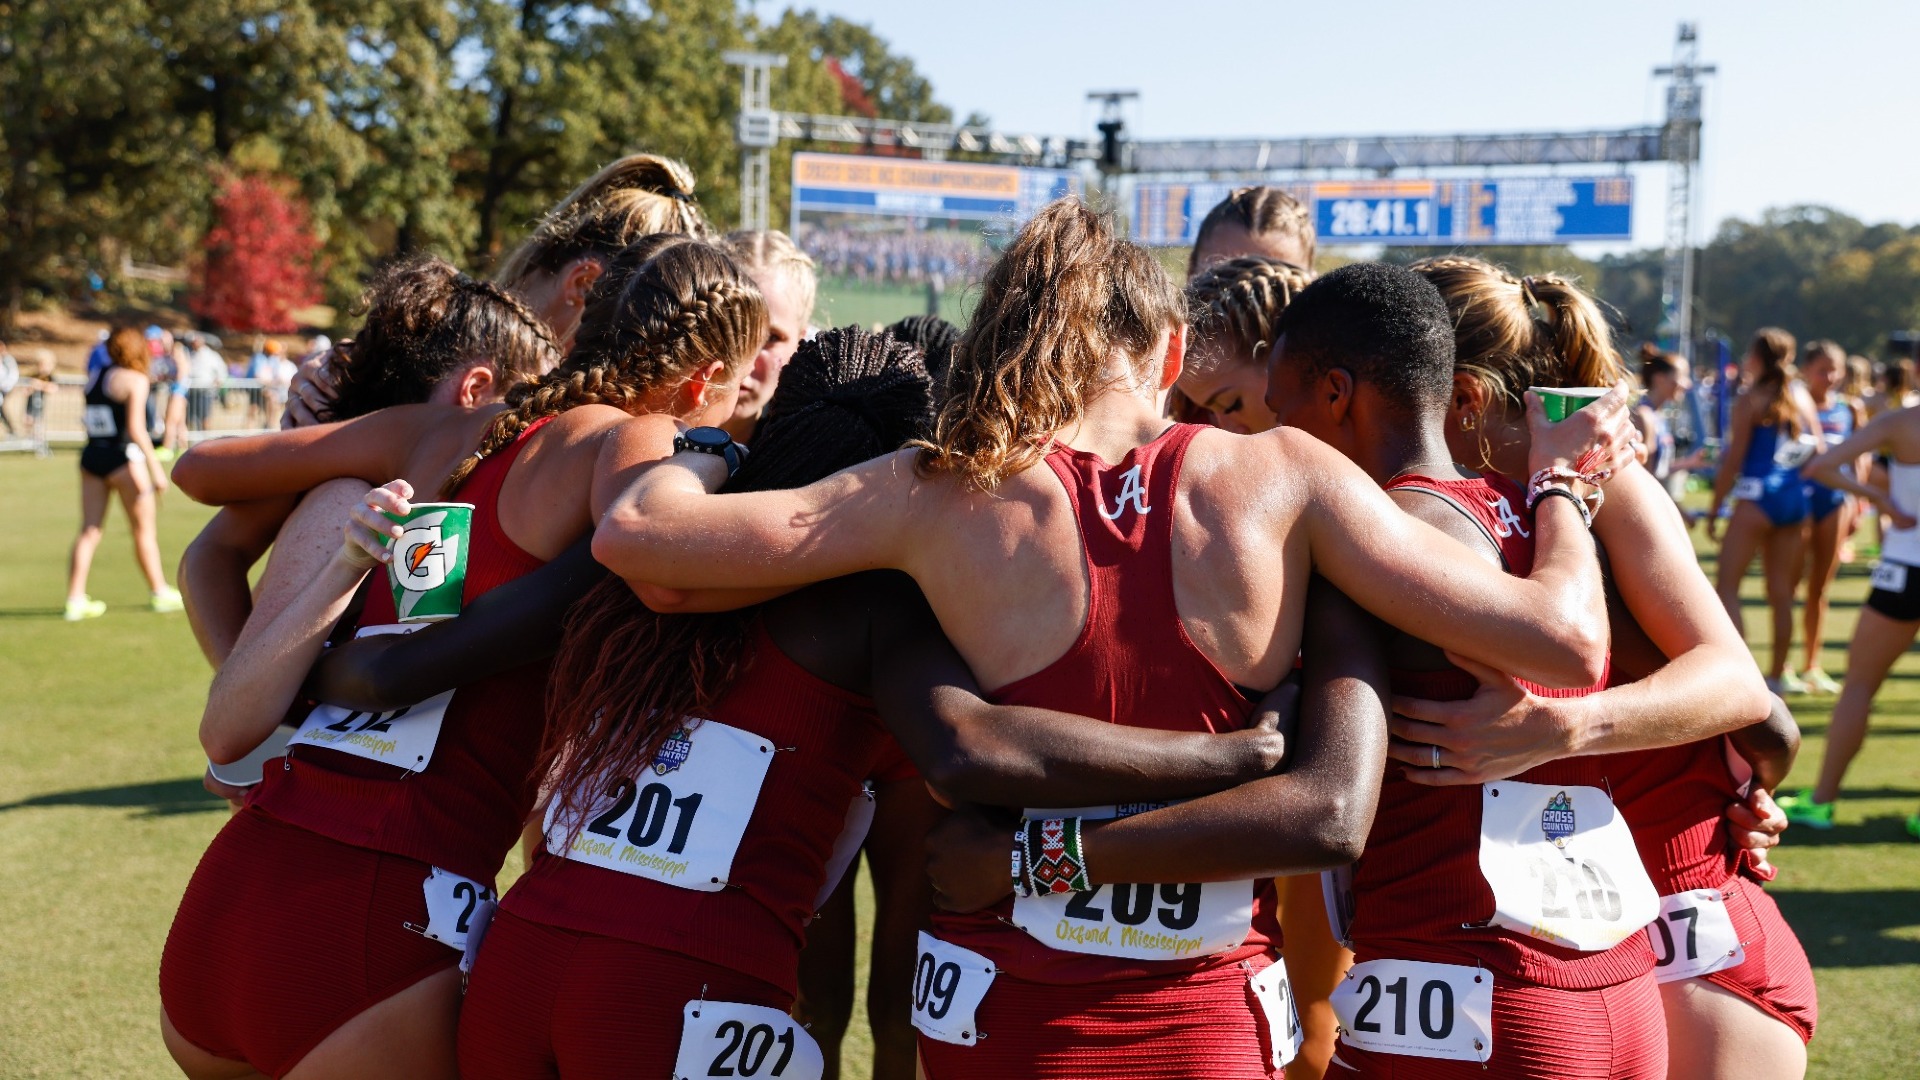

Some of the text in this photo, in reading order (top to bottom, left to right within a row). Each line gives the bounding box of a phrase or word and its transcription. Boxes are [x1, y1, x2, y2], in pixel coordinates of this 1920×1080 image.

[1099, 464, 1152, 519] A
[1486, 496, 1530, 538] A
[393, 525, 446, 592] G
[587, 777, 703, 854] 201
[1542, 822, 1574, 831] COUNTRY
[1543, 810, 1574, 823] CROSS
[619, 845, 690, 878] Mississippi
[1120, 925, 1203, 955] Mississippi
[1646, 907, 1698, 967] 07
[912, 952, 961, 1020] 09
[1354, 975, 1454, 1039] 210
[707, 1020, 794, 1077] 201
